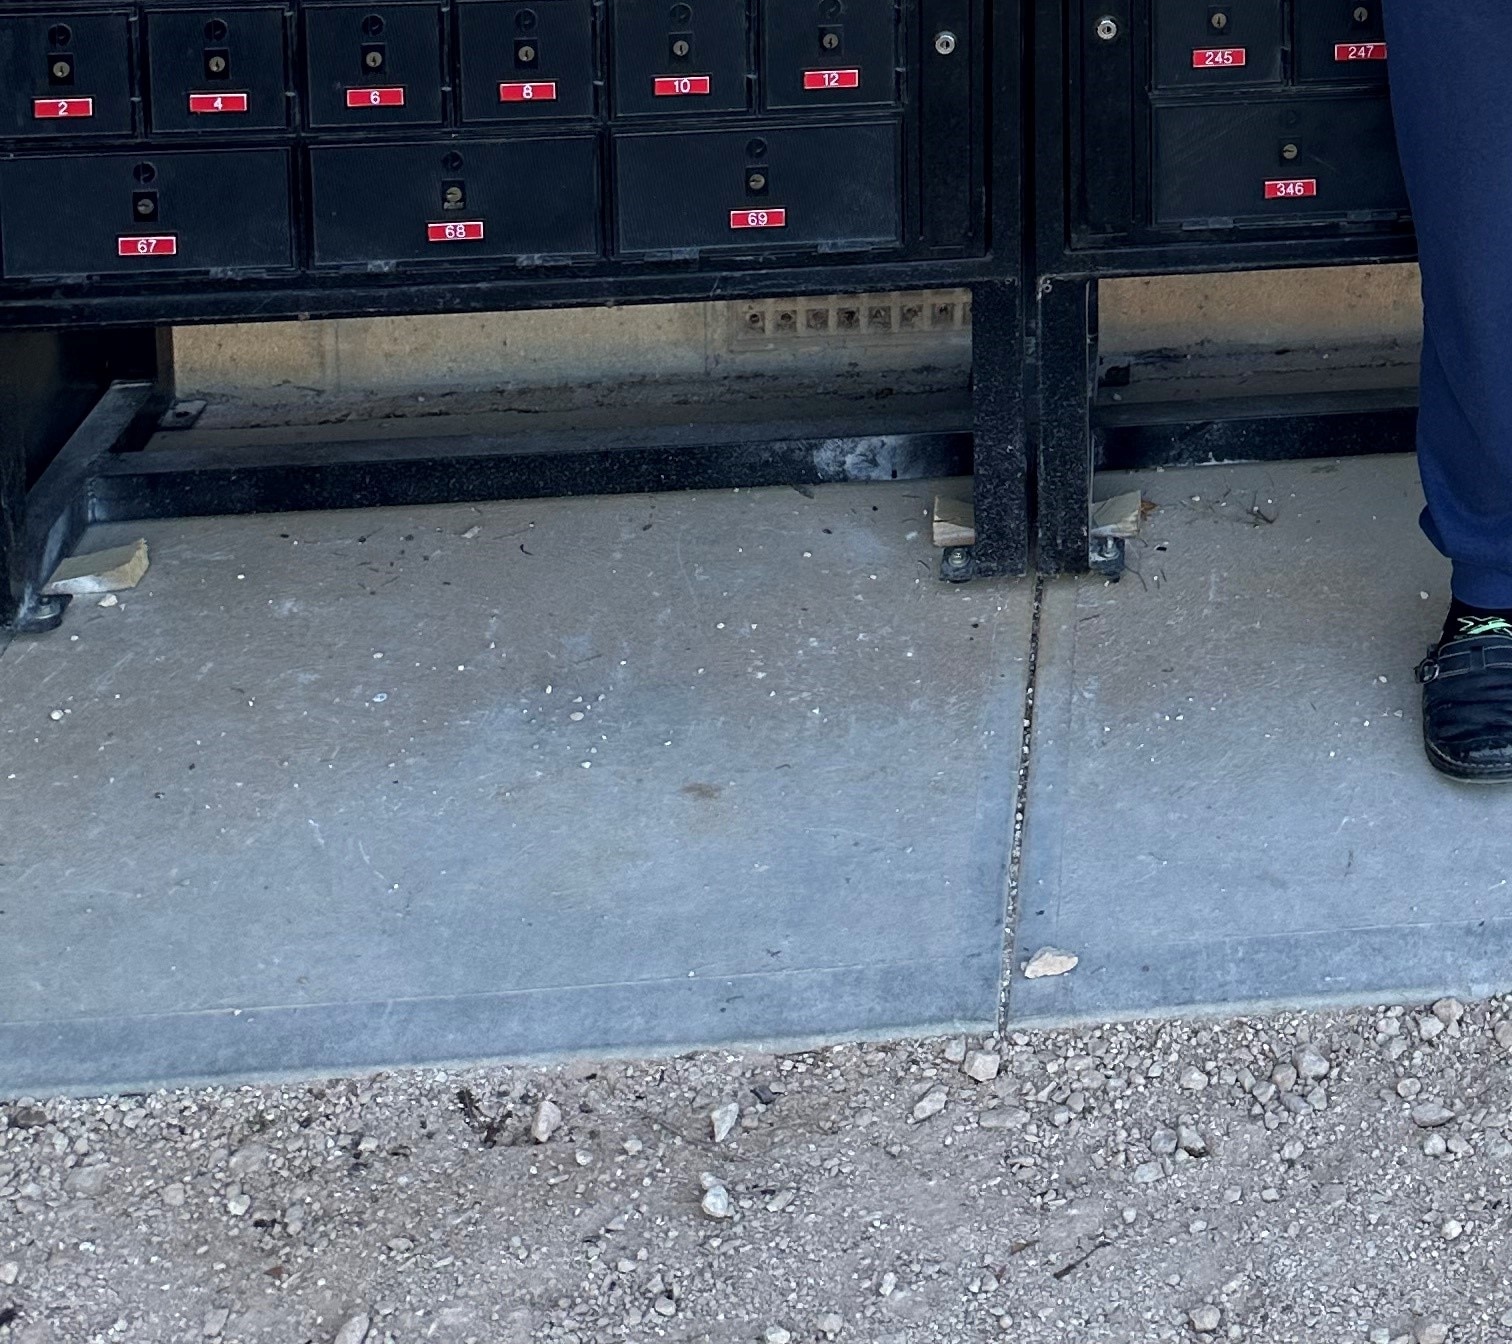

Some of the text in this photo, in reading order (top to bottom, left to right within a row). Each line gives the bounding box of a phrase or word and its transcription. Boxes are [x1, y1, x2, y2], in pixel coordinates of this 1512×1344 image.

[1205, 50, 1233, 66] 245
[1348, 46, 1374, 61] 247
[673, 79, 691, 95] 10
[822, 72, 839, 87] 12
[370, 90, 381, 105] 6
[522, 84, 533, 99] 8
[58, 101, 69, 117] 2
[213, 96, 223, 112] 4
[1276, 182, 1304, 197] 346
[747, 210, 768, 227] 69
[445, 223, 466, 239] 68
[137, 239, 158, 254] 67
